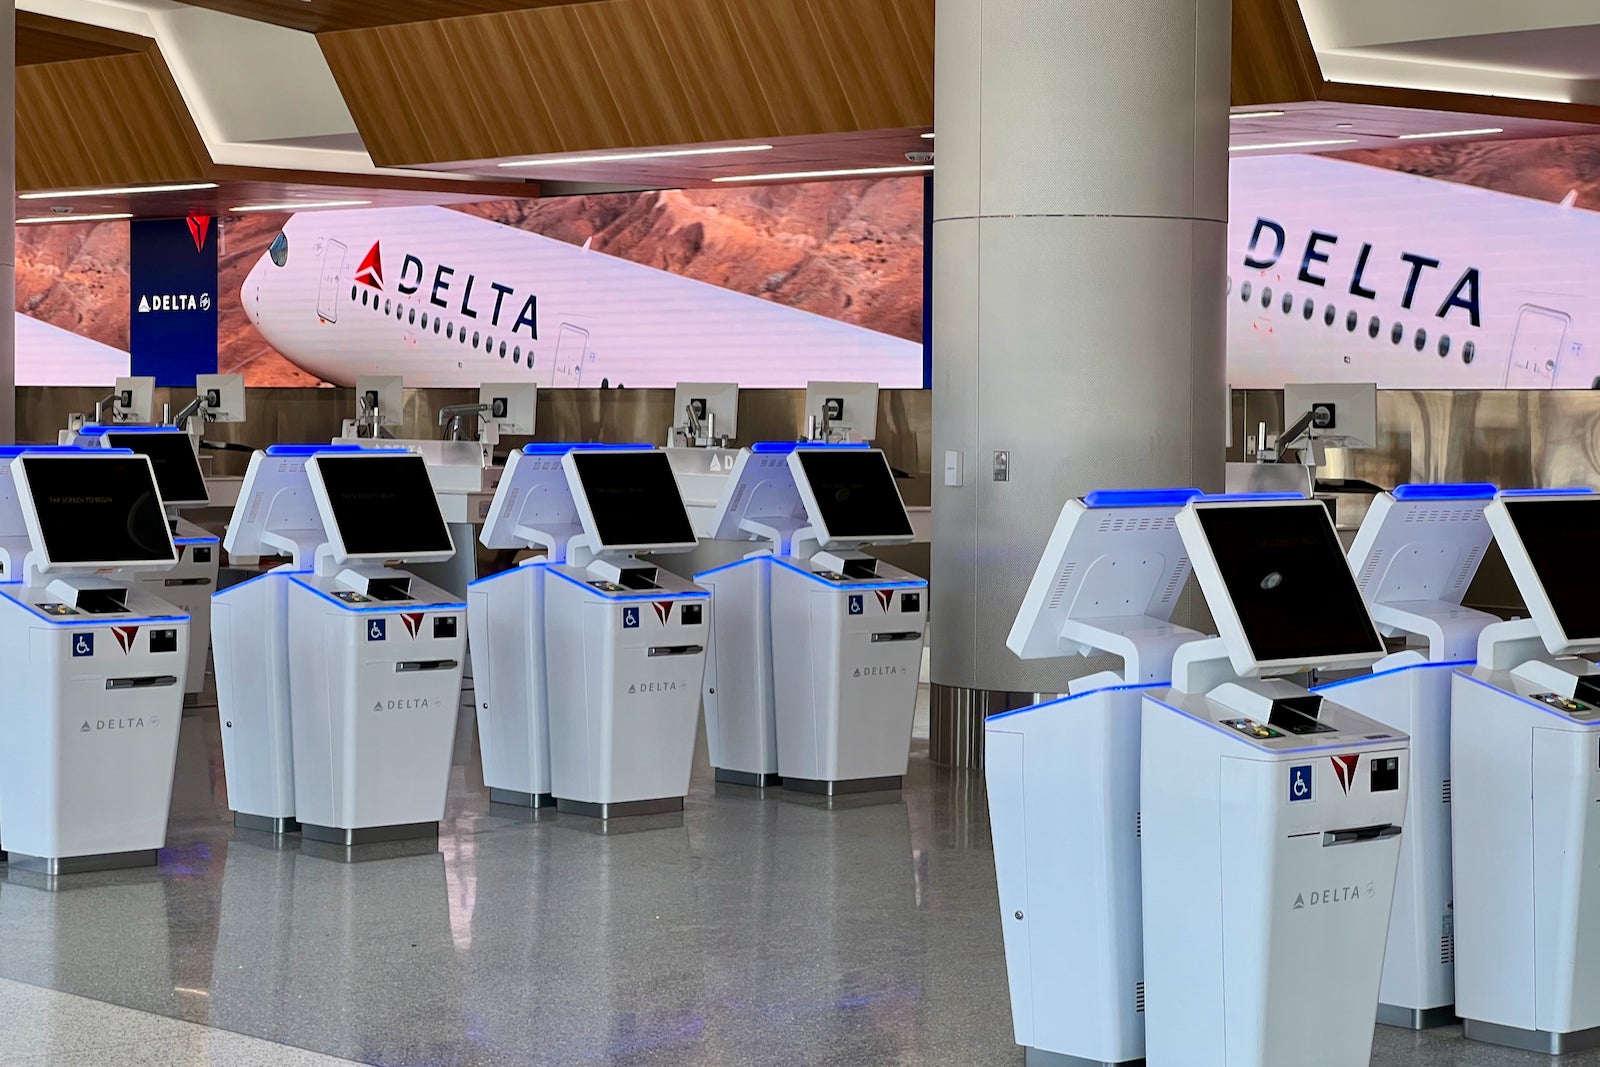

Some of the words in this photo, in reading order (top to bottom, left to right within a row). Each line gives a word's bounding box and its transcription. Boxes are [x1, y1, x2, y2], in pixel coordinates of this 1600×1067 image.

[1243, 216, 1482, 328] DELTA
[152, 294, 197, 311] DELTA
[397, 253, 538, 341] DELTA
[863, 666, 897, 676] DELTA
[640, 681, 676, 693] DELTA
[387, 698, 428, 710] DELTA
[96, 717, 144, 730] DELTA
[1310, 885, 1360, 906] DELTA
